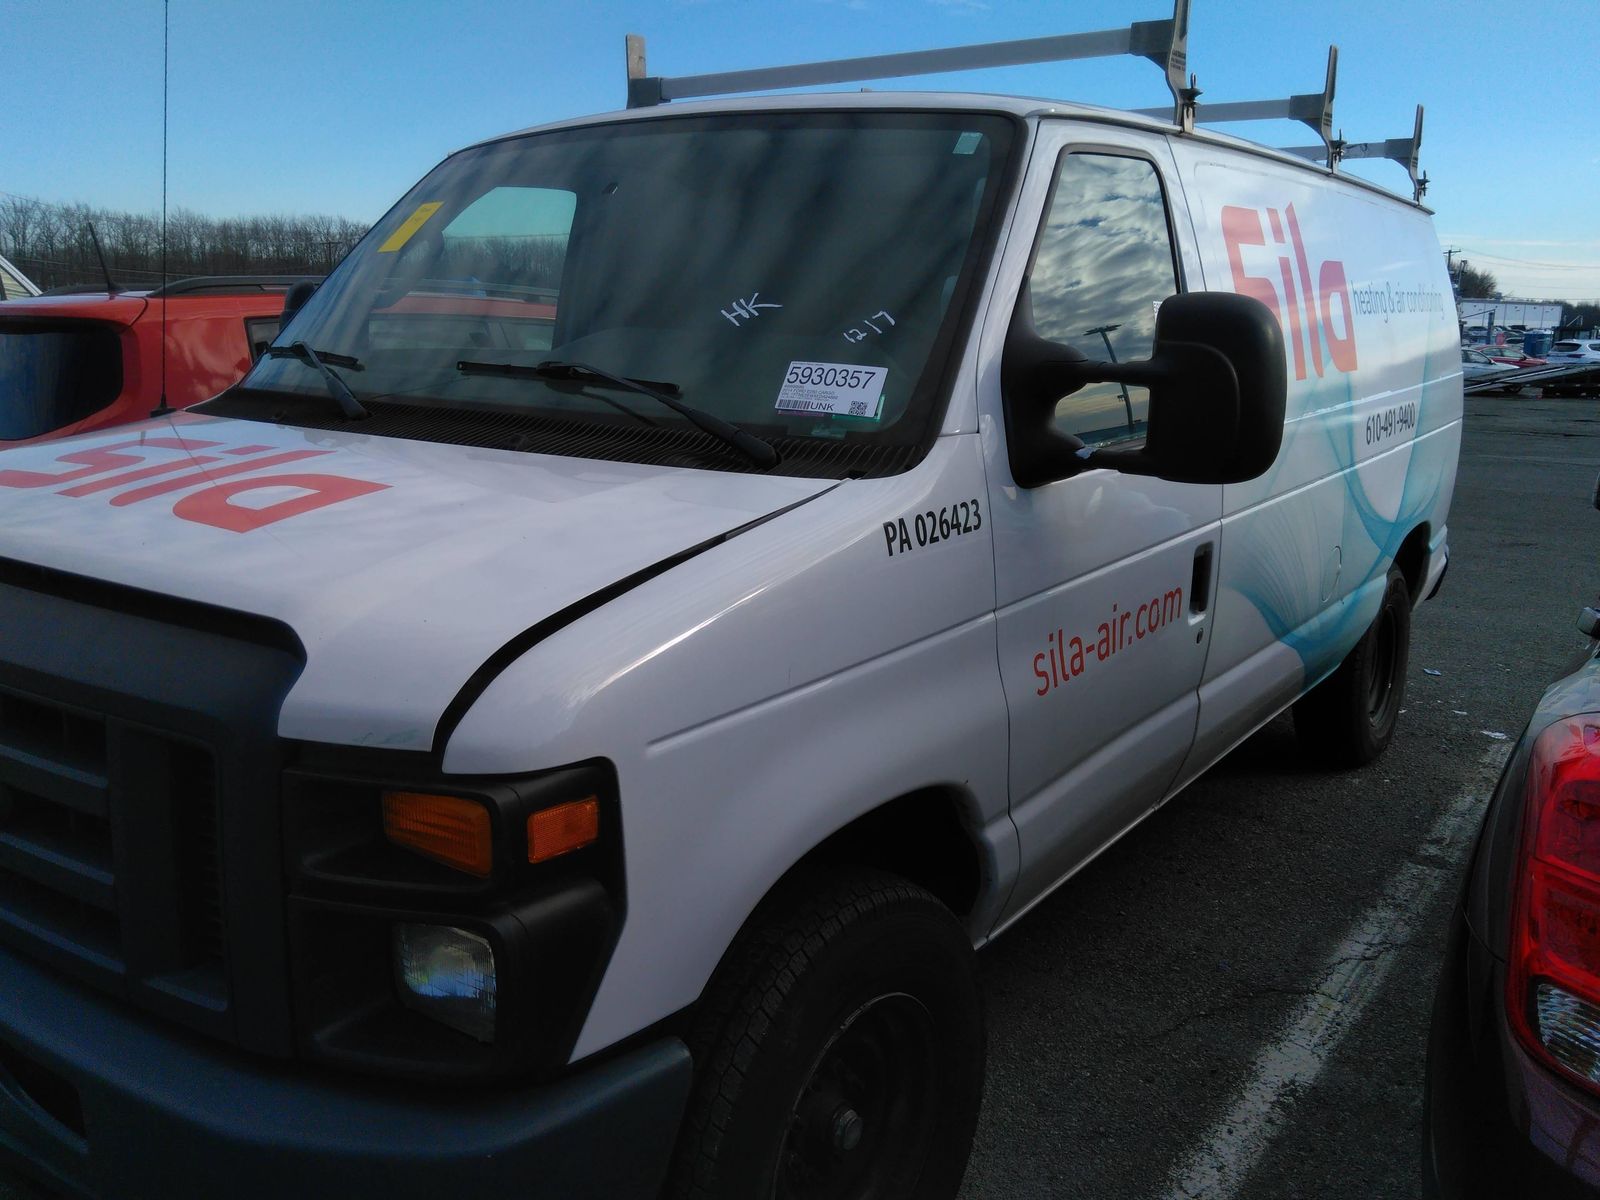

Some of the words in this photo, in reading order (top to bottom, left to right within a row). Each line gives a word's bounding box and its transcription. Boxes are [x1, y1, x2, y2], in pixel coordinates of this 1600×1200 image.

[721, 292, 783, 327] HK
[1350, 280, 1388, 324] heating
[1386, 281, 1395, 313] &
[1395, 282, 1406, 313] air
[786, 366, 876, 390] 5930357
[810, 401, 834, 411] UNK
[1366, 402, 1415, 445] 610-491-9400
[883, 518, 912, 556] PA
[915, 498, 982, 547] 026423
[1032, 585, 1182, 697] sila-air.com
